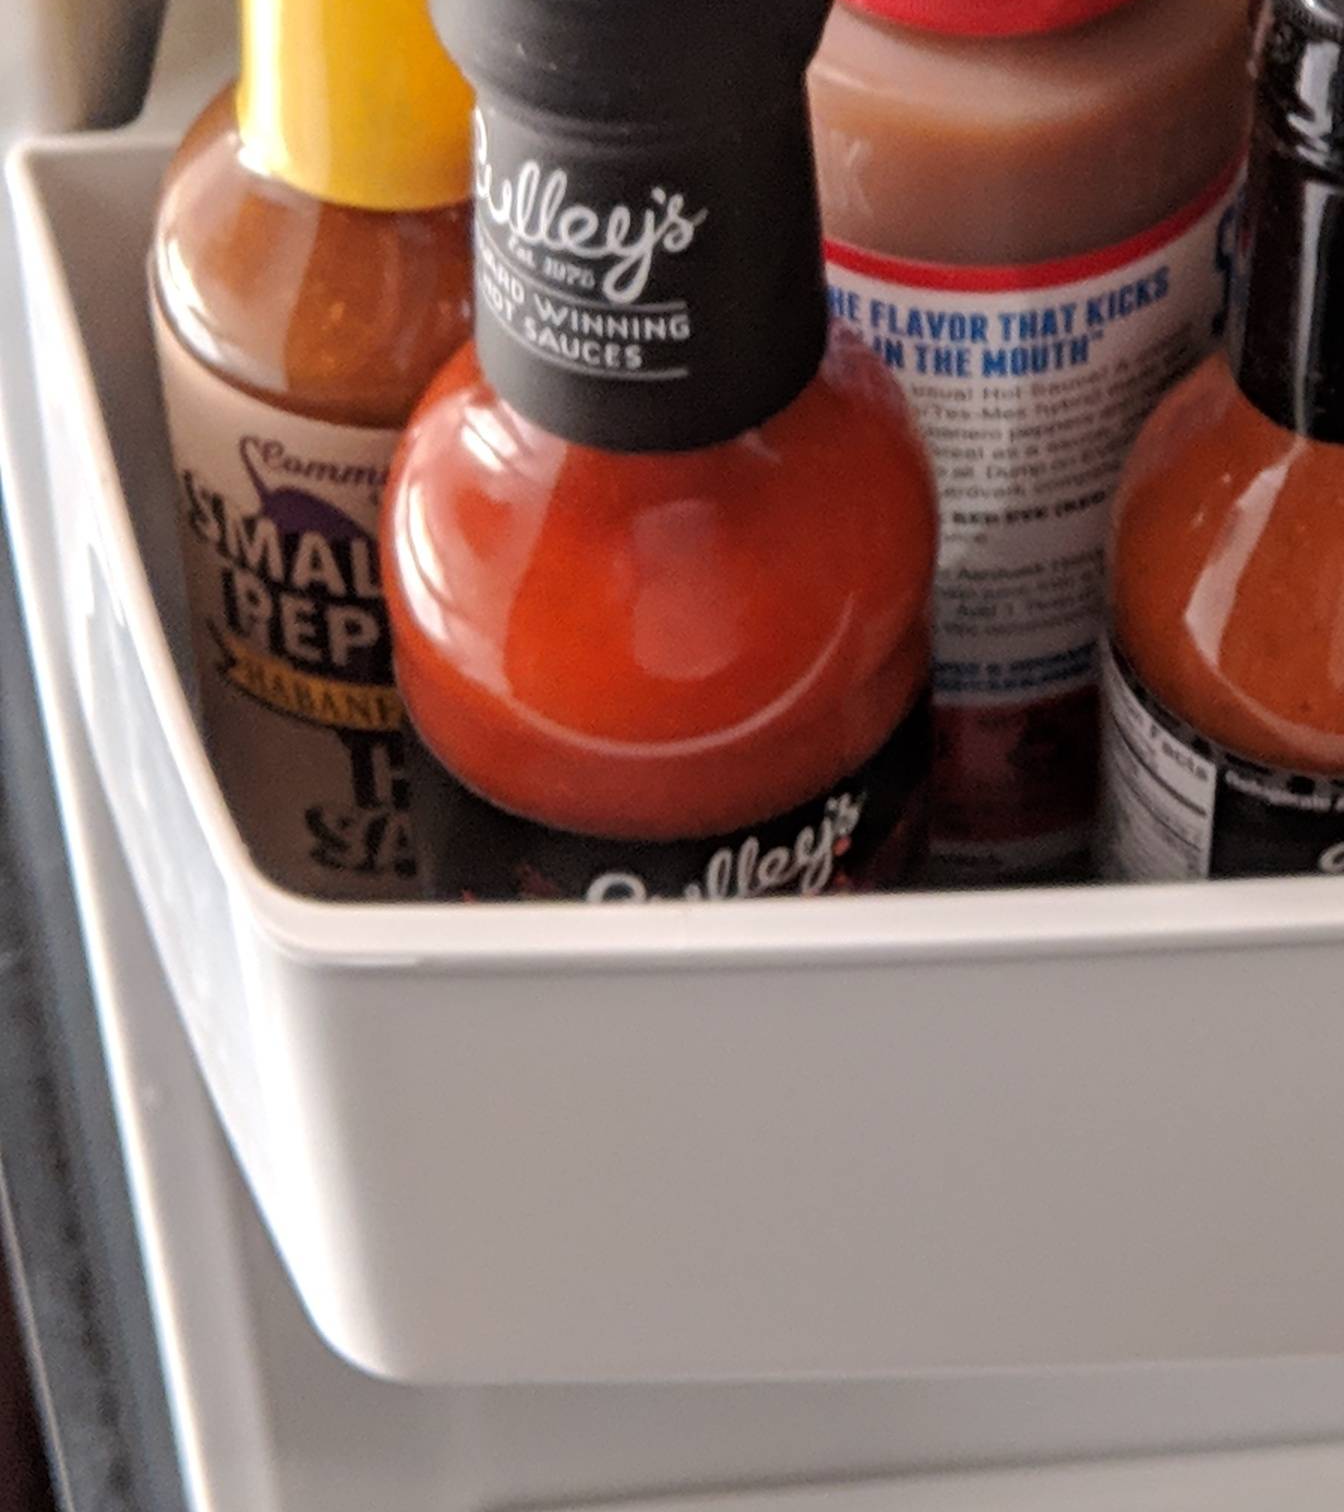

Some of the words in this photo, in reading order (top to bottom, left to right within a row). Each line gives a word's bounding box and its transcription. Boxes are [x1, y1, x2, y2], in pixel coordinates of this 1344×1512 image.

[534, 292, 691, 341] WINNING
[828, 284, 861, 323] HE
[869, 297, 988, 344] FLAVOR
[998, 301, 1079, 342] THAT
[1087, 266, 1171, 327] KICKS
[524, 316, 643, 370] SAUCES
[873, 335, 906, 373] IN
[913, 341, 972, 379] THE
[261, 439, 390, 487] Comm
